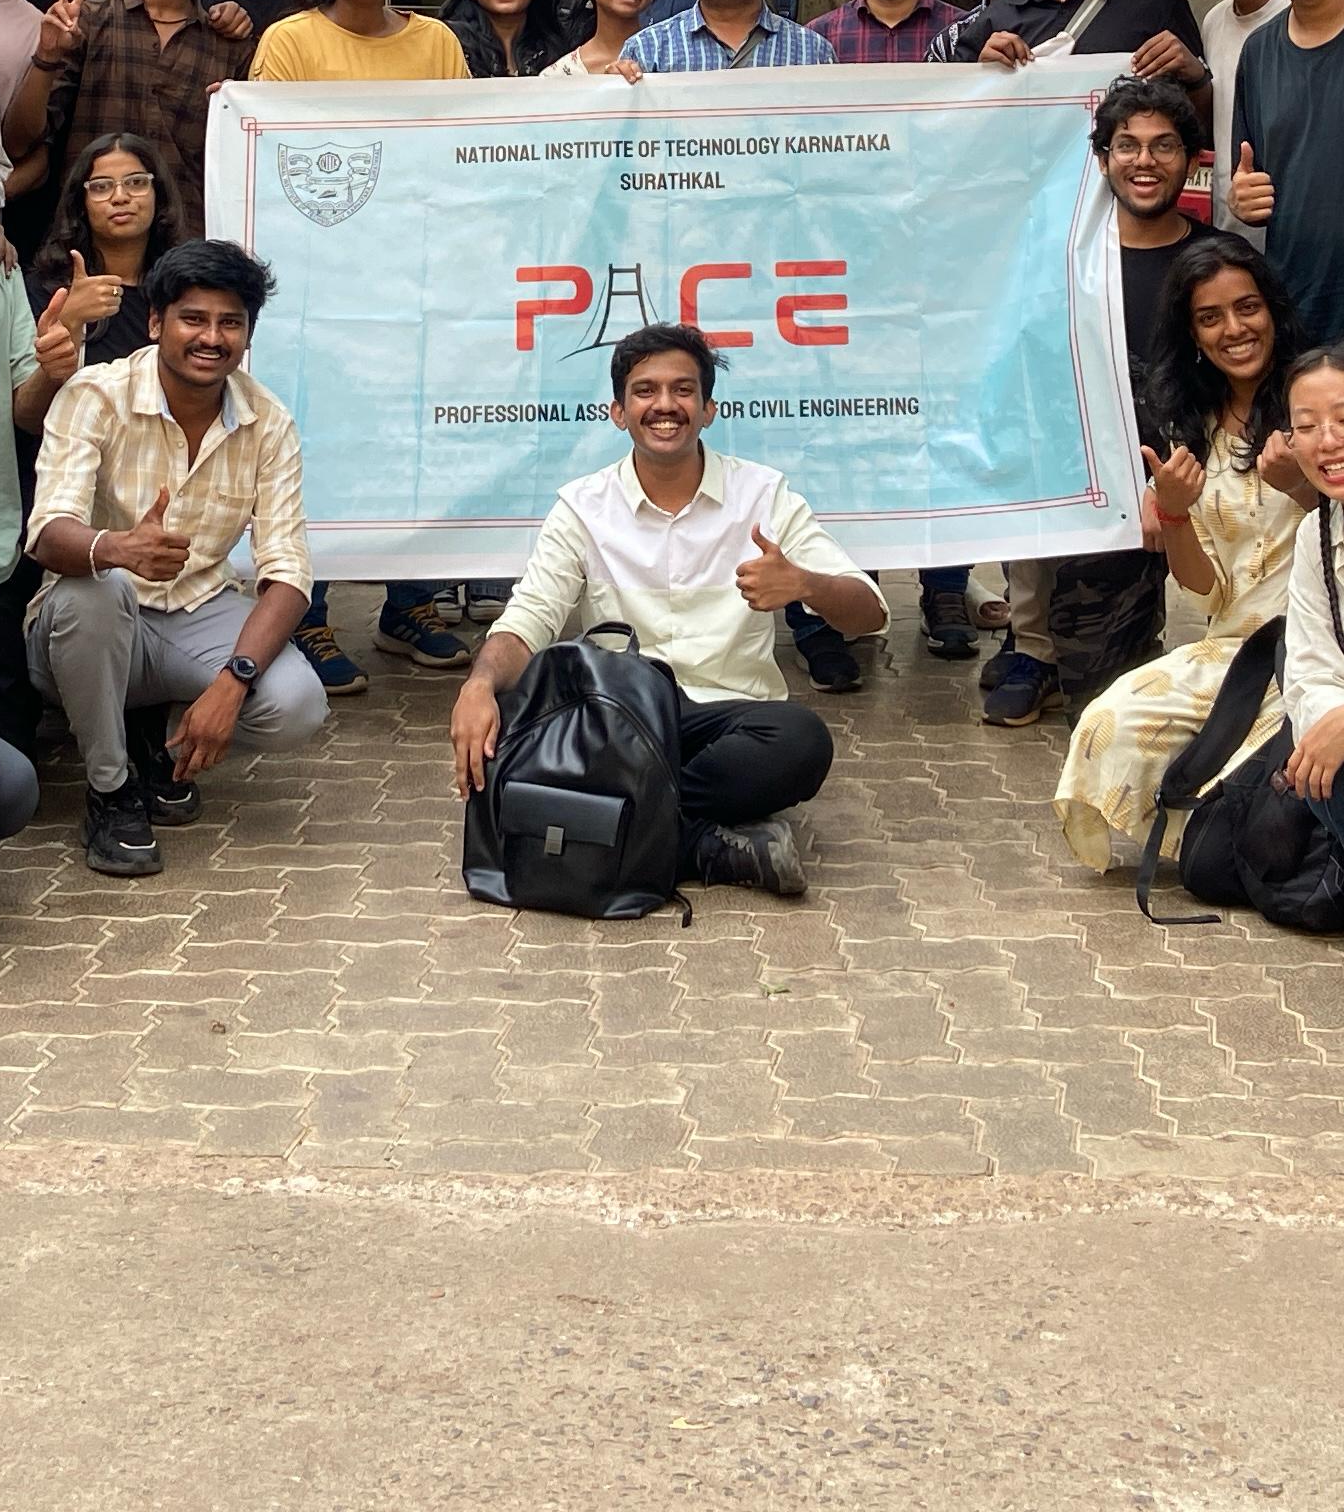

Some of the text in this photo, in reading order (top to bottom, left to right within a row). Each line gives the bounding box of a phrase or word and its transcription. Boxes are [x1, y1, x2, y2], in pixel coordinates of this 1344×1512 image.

[455, 133, 891, 164] NATIONAL INSTITUTE OF TECHNOLOGY KARNATAKA
[620, 171, 726, 191] SURATHKAL
[434, 403, 570, 424] PROFESSIONAL
[749, 399, 795, 418] CIVIL
[800, 397, 920, 418] ENGINEERING
